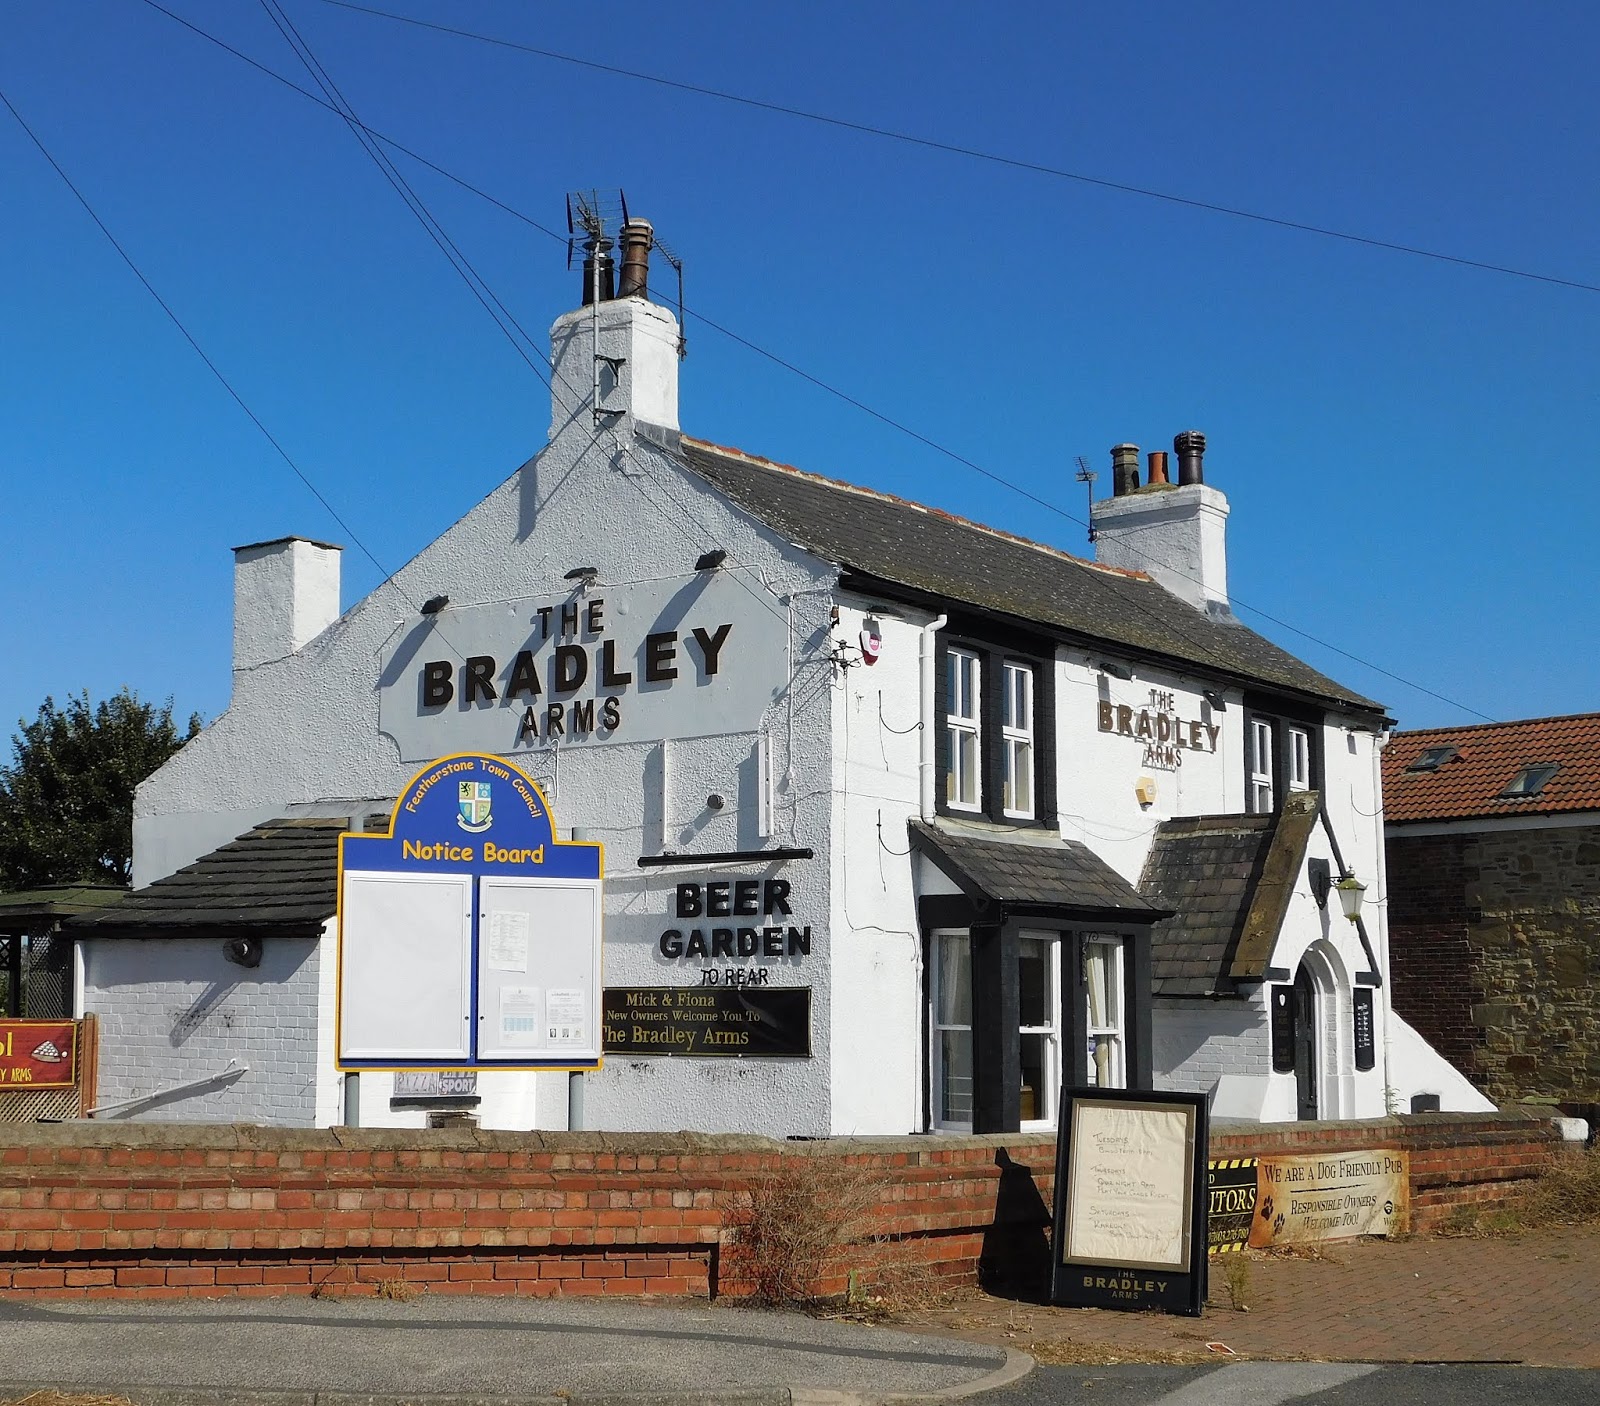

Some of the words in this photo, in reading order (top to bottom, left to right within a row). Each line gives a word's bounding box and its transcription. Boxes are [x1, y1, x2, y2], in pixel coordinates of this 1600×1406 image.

[536, 599, 605, 639] THE
[423, 624, 733, 707] BRADLEY
[1149, 688, 1175, 712] THE
[519, 696, 620, 739] ARMS
[1098, 699, 1221, 753] BRADLEY
[1146, 743, 1182, 768] ARMS
[405, 761, 475, 813] Featherstone
[480, 759, 510, 780] Town
[512, 778, 542, 818] Council
[402, 839, 473, 861] Notice
[483, 842, 544, 864] Board
[676, 879, 793, 918] BEER
[659, 926, 811, 959] GARDEN
[701, 969, 719, 985] TO
[725, 968, 768, 985] REAR
[626, 992, 657, 1007] Mick
[662, 992, 673, 1007] &
[677, 992, 715, 1007] Fiona
[607, 1010, 628, 1021] New
[631, 1010, 668, 1021] Owners
[672, 1010, 719, 1022] Welcome
[722, 1010, 742, 1022] You
[746, 1010, 761, 1022] To
[632, 1026, 697, 1051] Bradley
[703, 1027, 749, 1045] Arms
[11, 1067, 32, 1082] ARMS
[442, 1078, 474, 1092] SPORT
[1264, 1164, 1282, 1182] WE
[1285, 1166, 1304, 1181] ARE
[1308, 1166, 1314, 1180] A
[1318, 1161, 1336, 1179] DOG
[1339, 1160, 1381, 1178] FRIENDLY
[1384, 1157, 1403, 1174] PUB
[1208, 1187, 1256, 1214] ITORS
[1291, 1198, 1342, 1215] RESPONSIBLE
[1344, 1195, 1377, 1210] OWNERS
[1303, 1216, 1341, 1230] WELCOME
[1083, 1276, 1168, 1293] BRADLEY
[1117, 1269, 1135, 1278] THE
[1112, 1290, 1139, 1300] ARMS
